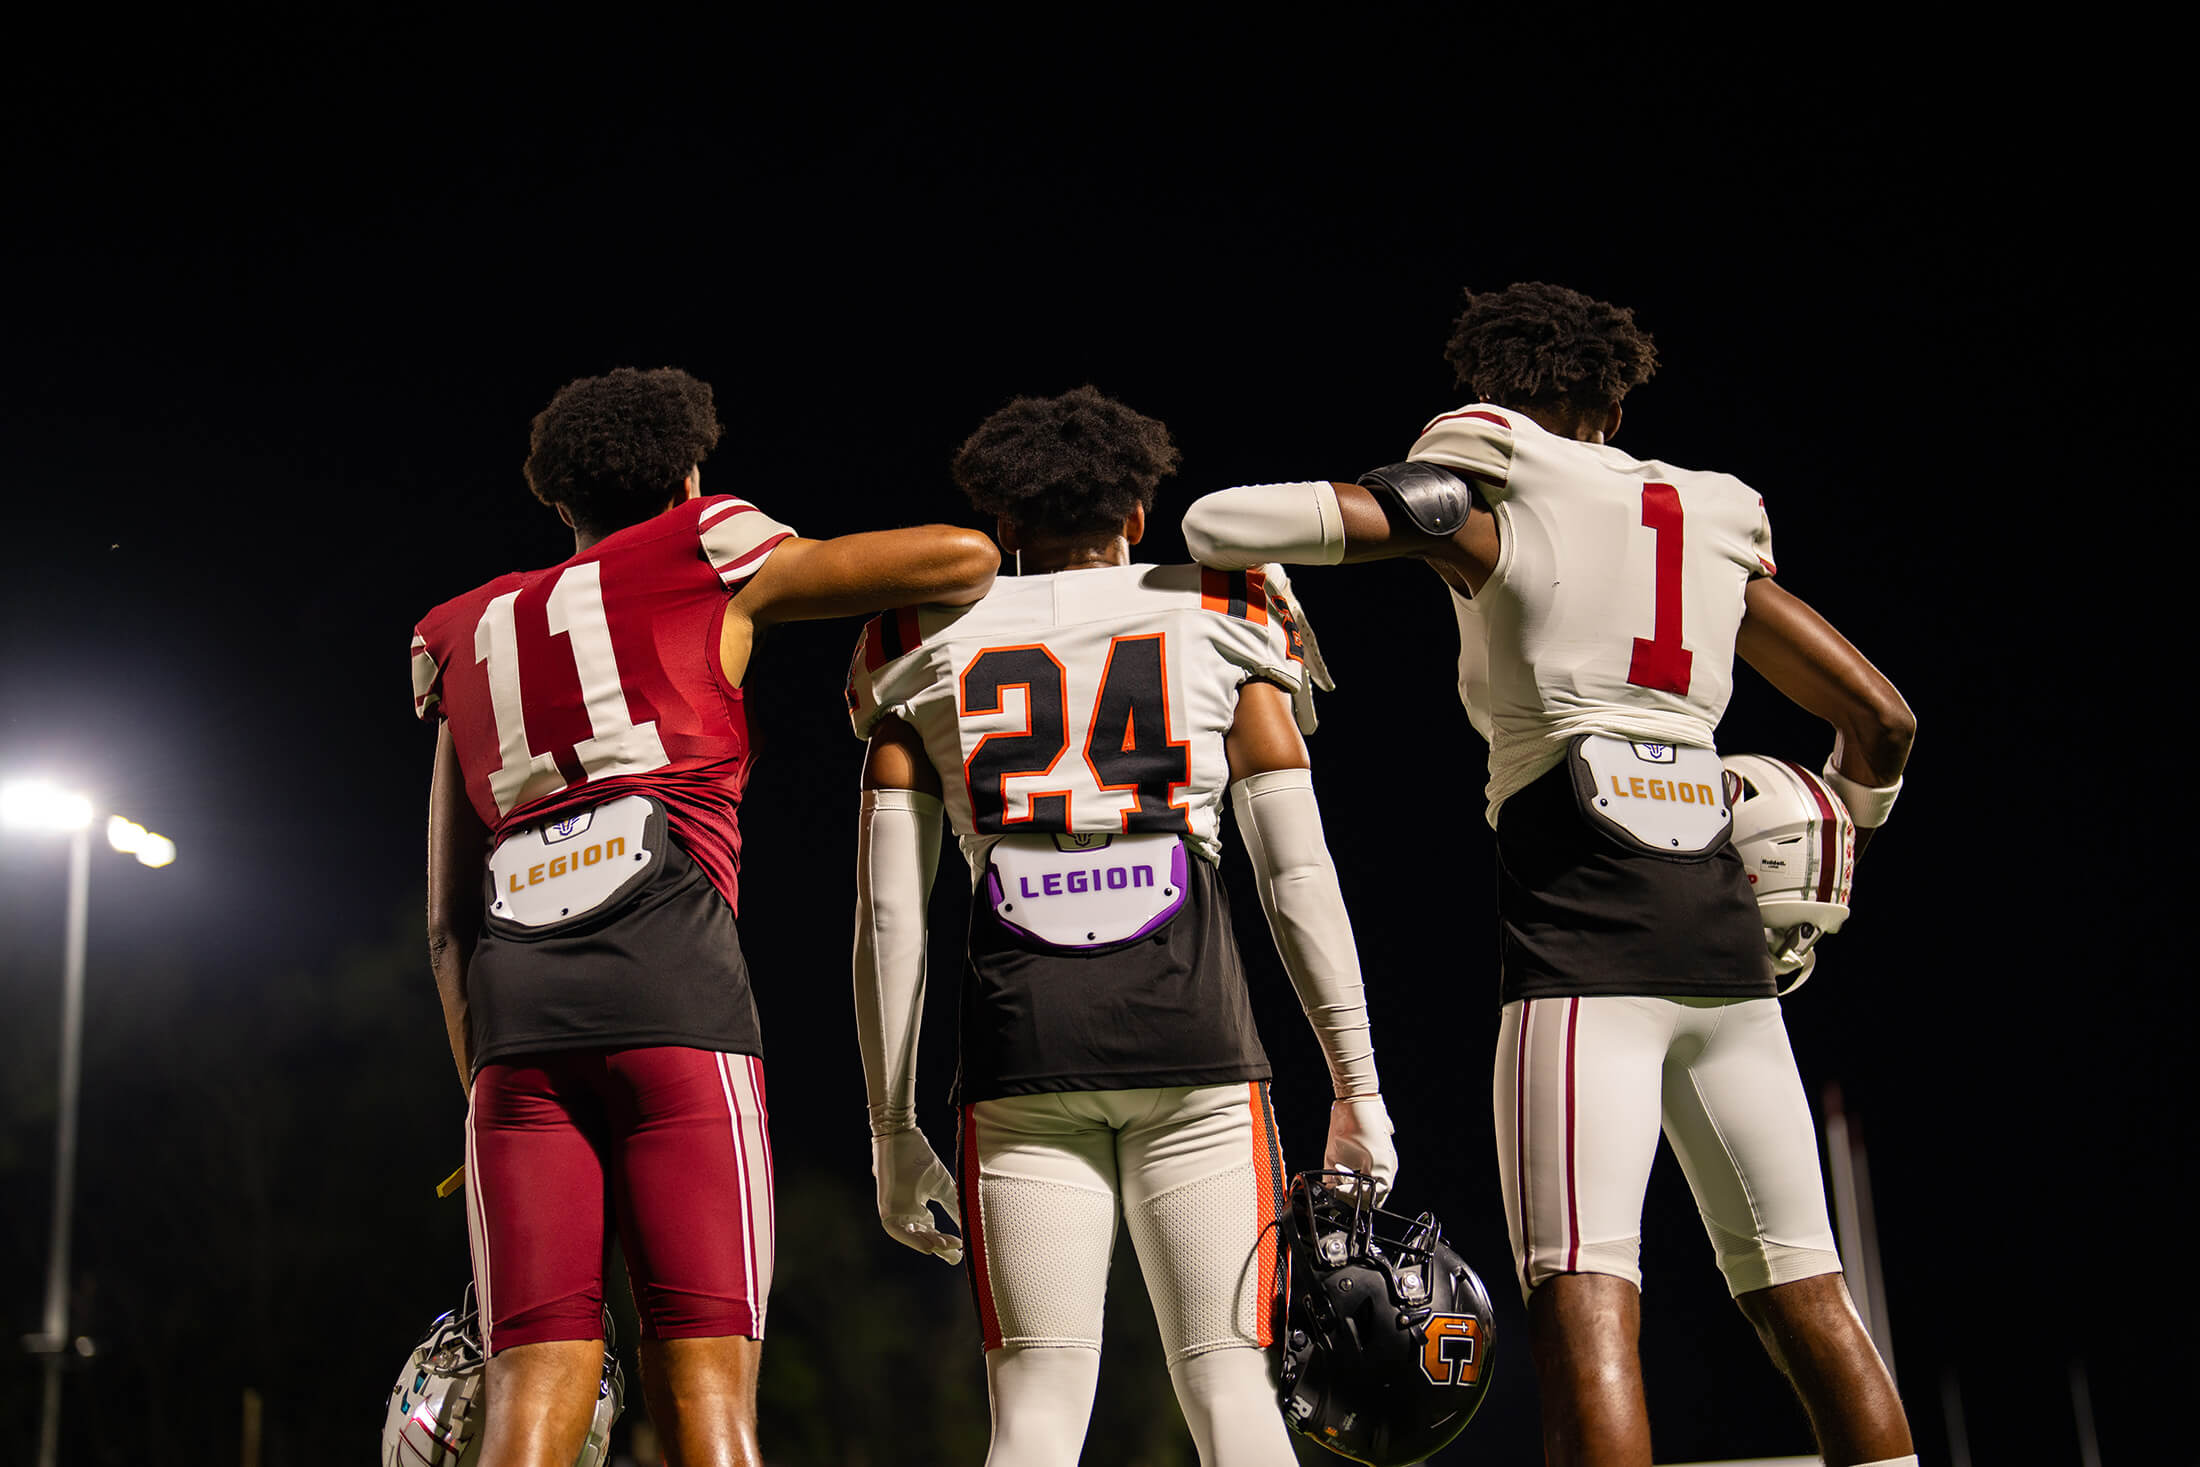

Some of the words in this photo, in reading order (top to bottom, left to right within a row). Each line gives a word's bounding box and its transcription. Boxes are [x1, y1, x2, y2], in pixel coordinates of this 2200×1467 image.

[1626, 482, 1693, 696] 1
[474, 560, 671, 818] 11
[959, 632, 1194, 834] 24
[1610, 775, 1715, 806] LEGION
[509, 836, 626, 893] LEGION
[1020, 864, 1154, 898] LEGION
